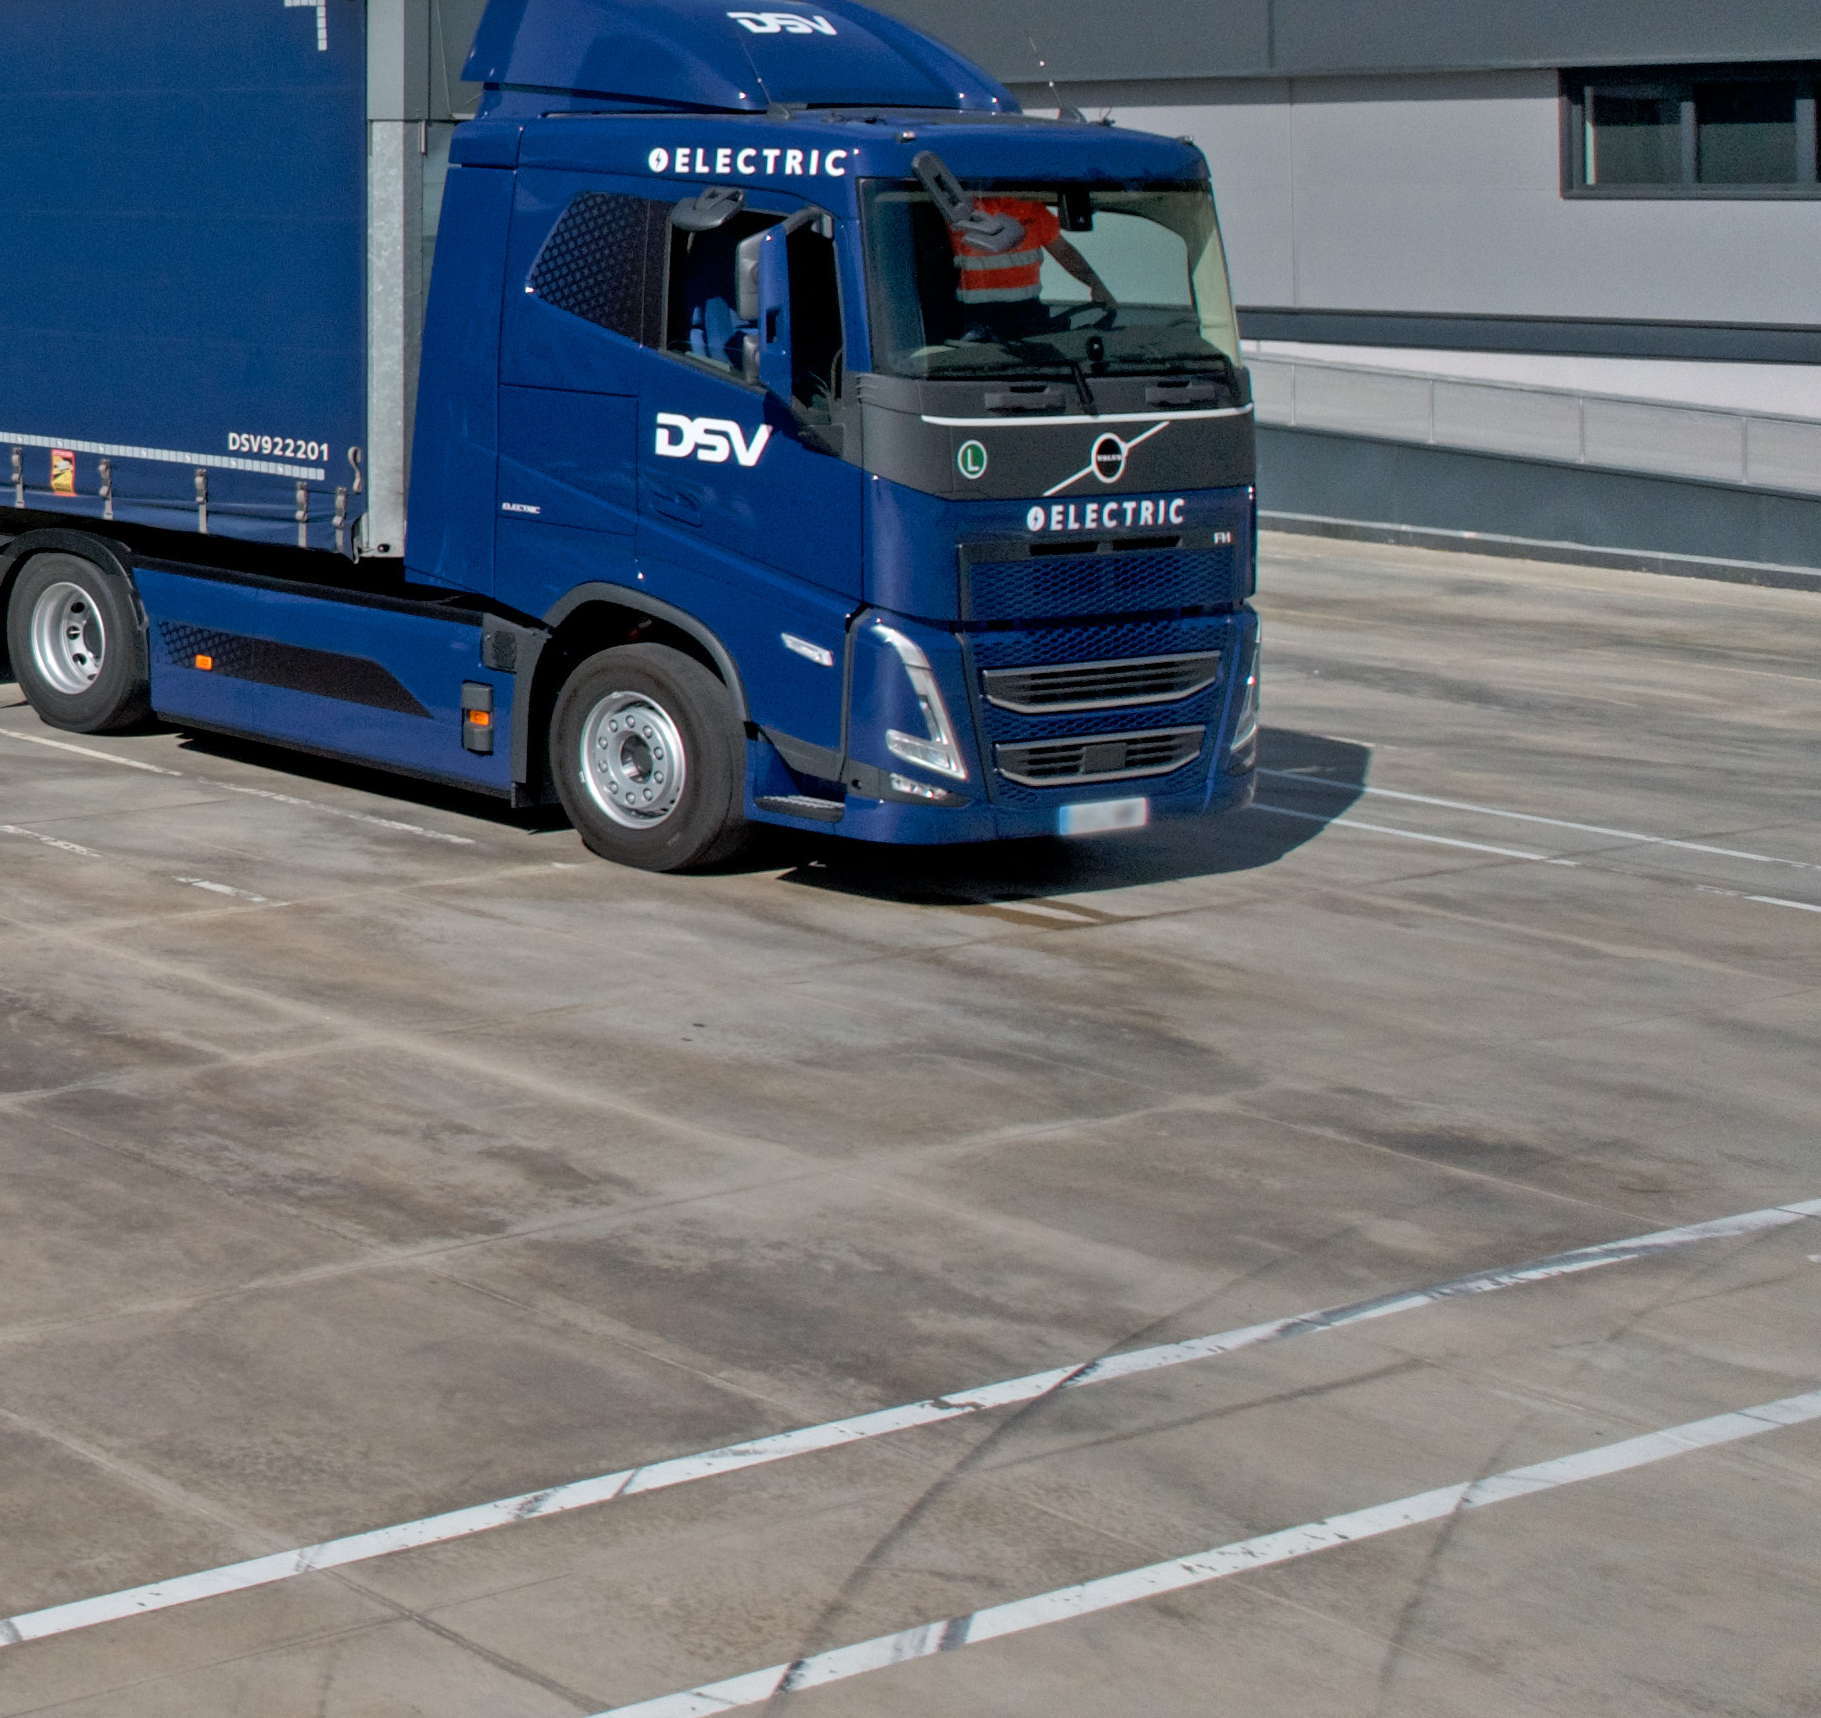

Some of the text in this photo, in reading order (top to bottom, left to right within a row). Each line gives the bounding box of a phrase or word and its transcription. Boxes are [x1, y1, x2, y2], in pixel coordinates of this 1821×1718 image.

[726, 11, 838, 35] DSV
[675, 147, 848, 177] ELECTRIC
[228, 432, 329, 461] DSV922201
[655, 411, 774, 467] DSV
[967, 448, 980, 472] L
[1049, 498, 1185, 531] ELECTRIC
[1213, 531, 1233, 544] FH
